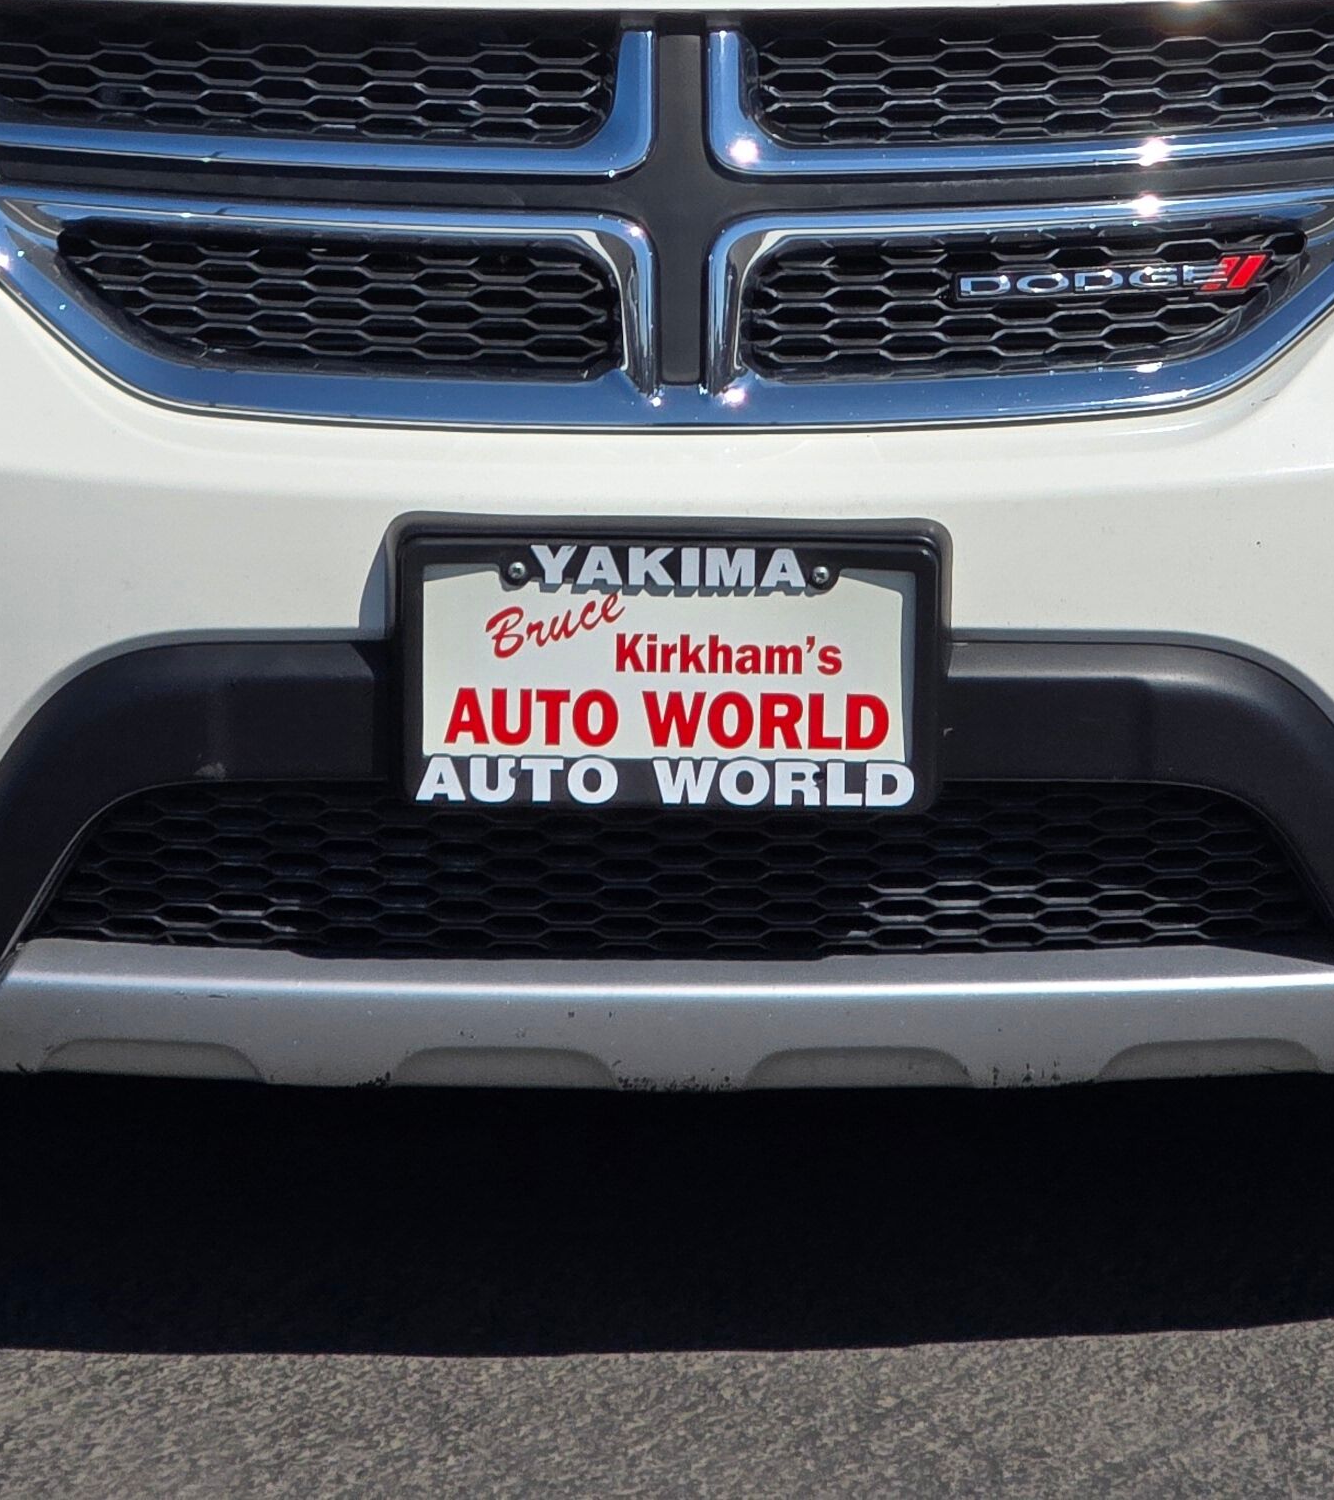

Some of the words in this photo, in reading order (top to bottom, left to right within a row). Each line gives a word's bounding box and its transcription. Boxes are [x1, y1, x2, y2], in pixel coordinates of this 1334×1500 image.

[959, 263, 1229, 297] DODGE
[530, 544, 809, 594] YAKIMA
[484, 591, 626, 659] Bruce
[614, 632, 844, 676] Kirkham's
[443, 687, 620, 746] AUTO
[642, 690, 890, 750] WORLD
[415, 754, 620, 805] AUTO
[652, 757, 916, 808] WORLD
